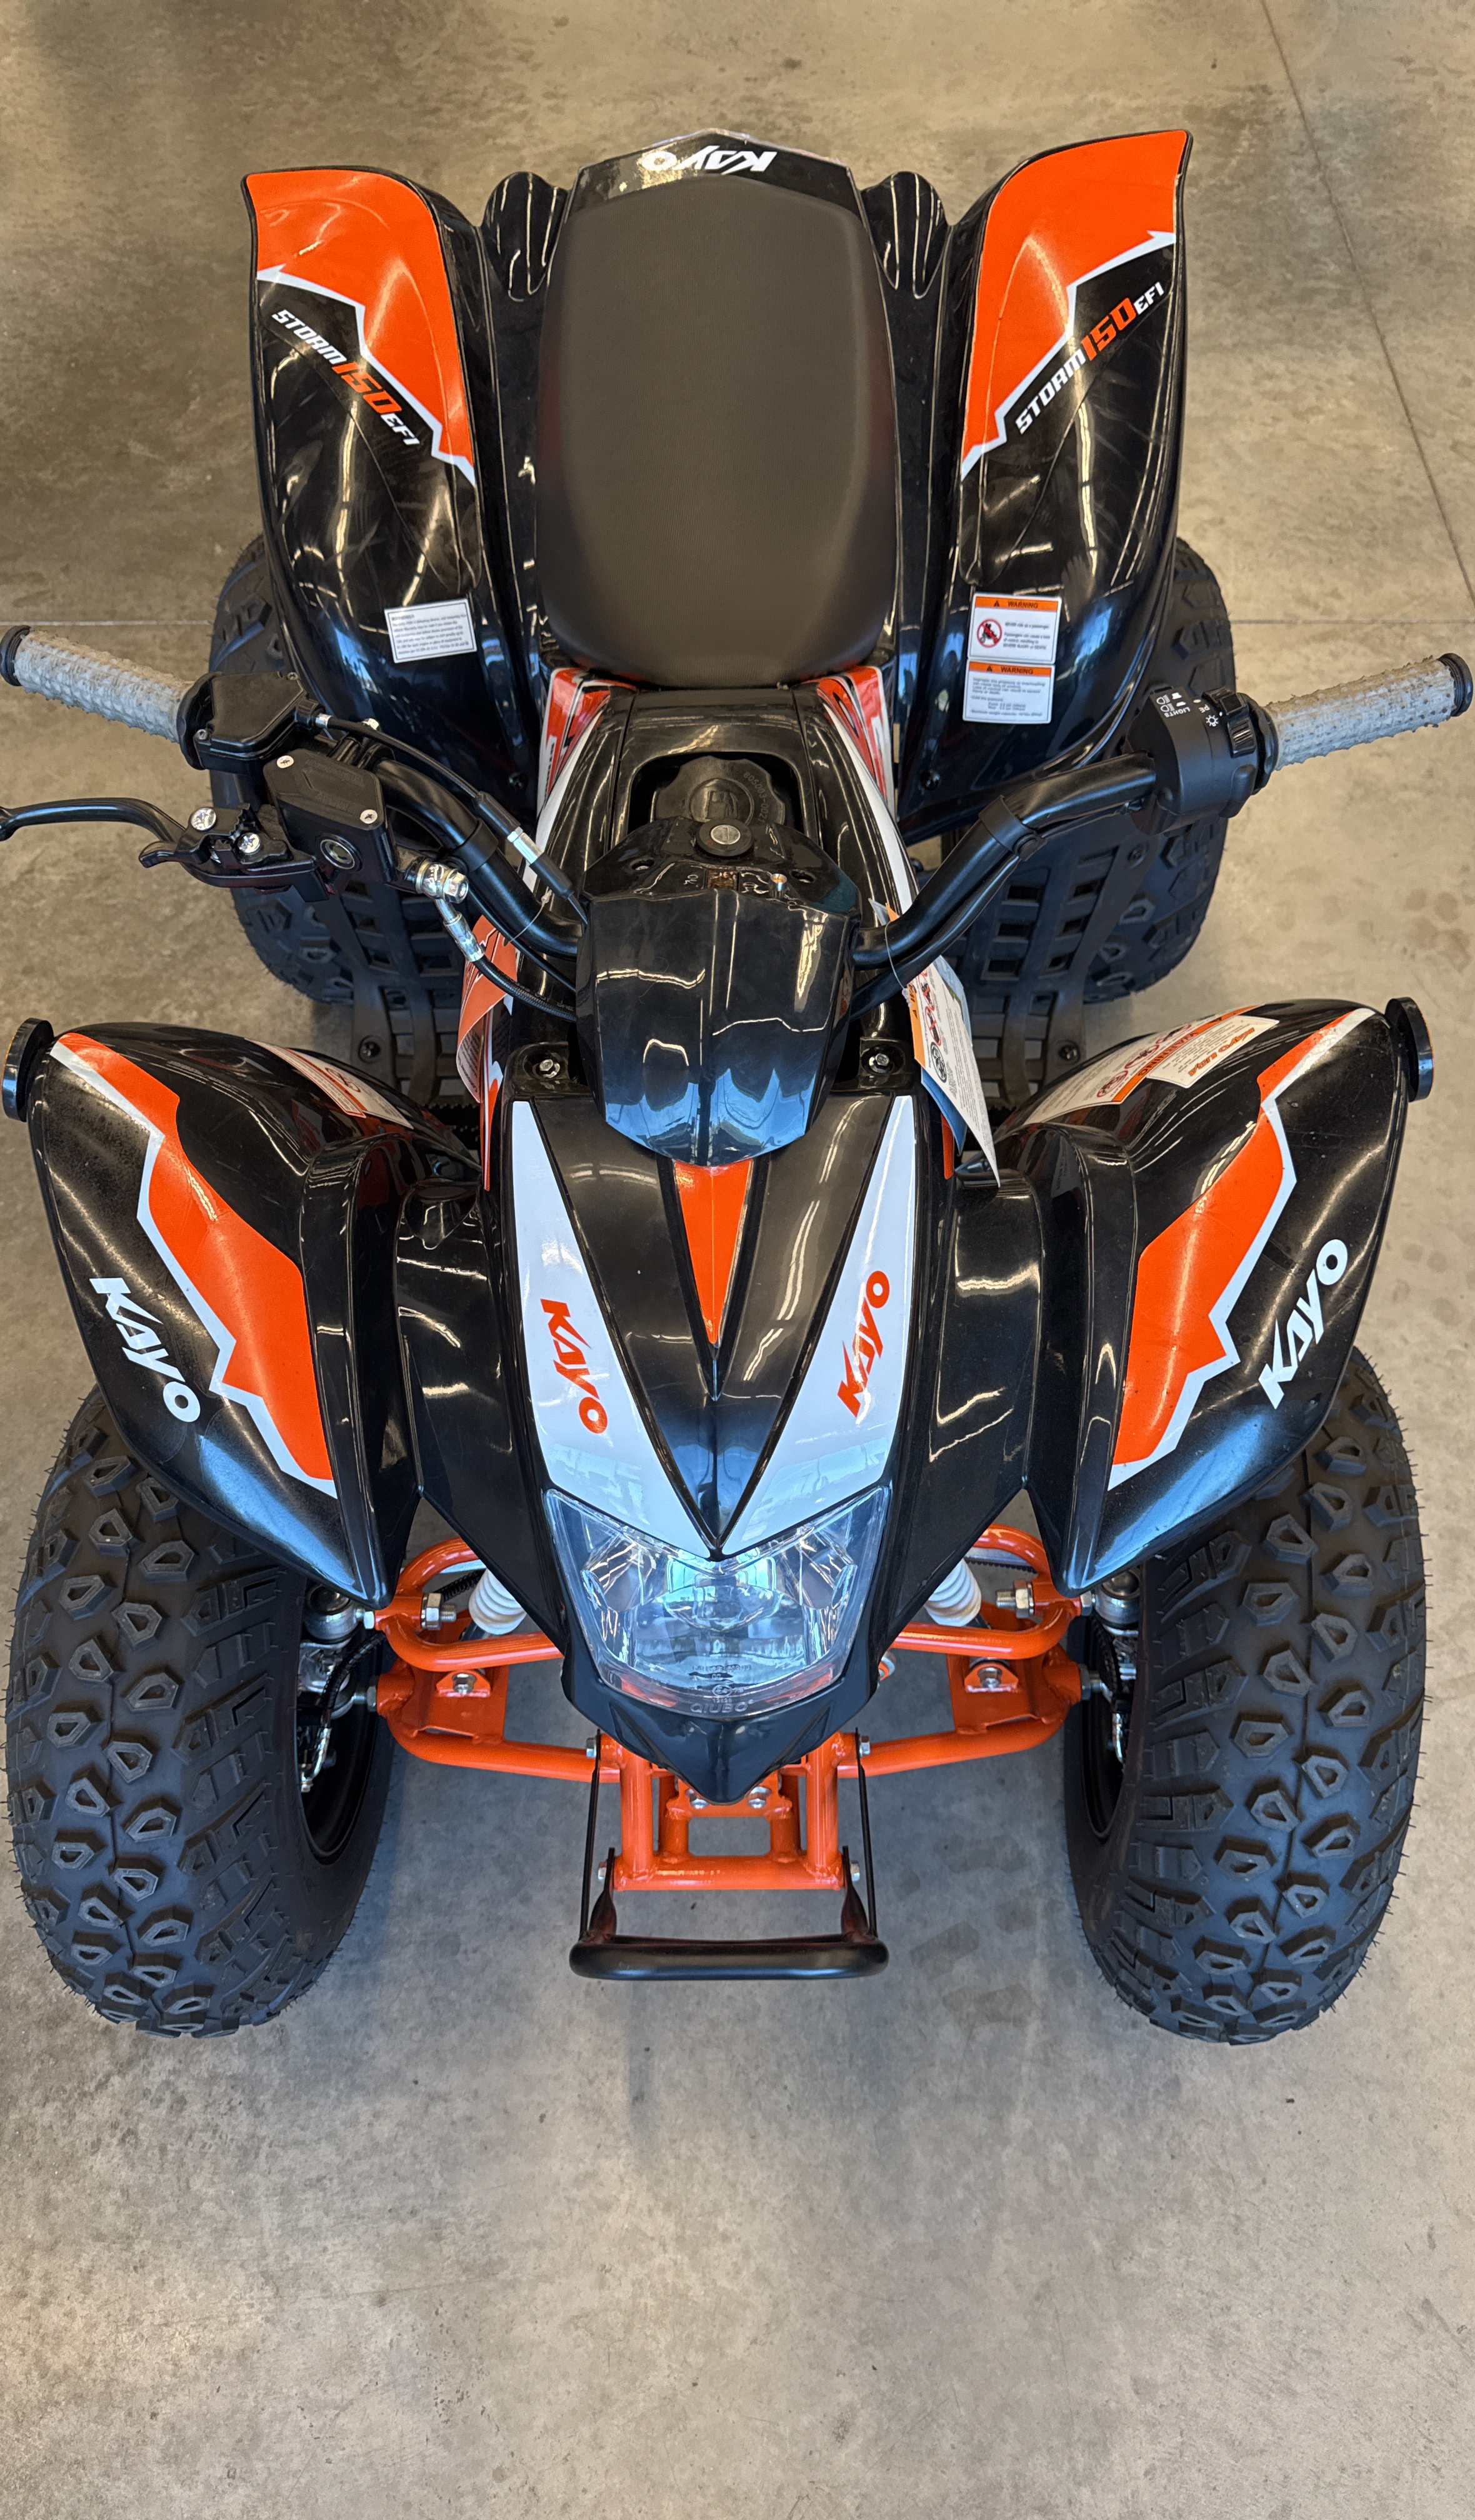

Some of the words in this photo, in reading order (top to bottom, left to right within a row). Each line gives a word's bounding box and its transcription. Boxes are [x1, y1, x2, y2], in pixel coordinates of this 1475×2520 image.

[641, 145, 778, 175] KAYO
[1007, 600, 1039, 609] WARNING
[1000, 666, 1034, 675] WARNING
[1164, 707, 1191, 718] LIGHTS
[1137, 1030, 1199, 1076] WARNING
[1218, 1026, 1255, 1054] KAYO
[1258, 1239, 1348, 1409] KAYO
[89, 1278, 201, 1422] KAYO
[838, 1271, 889, 1416] KAYO
[540, 1298, 608, 1434] KAYO
[690, 1701, 748, 1714] QIUBO
